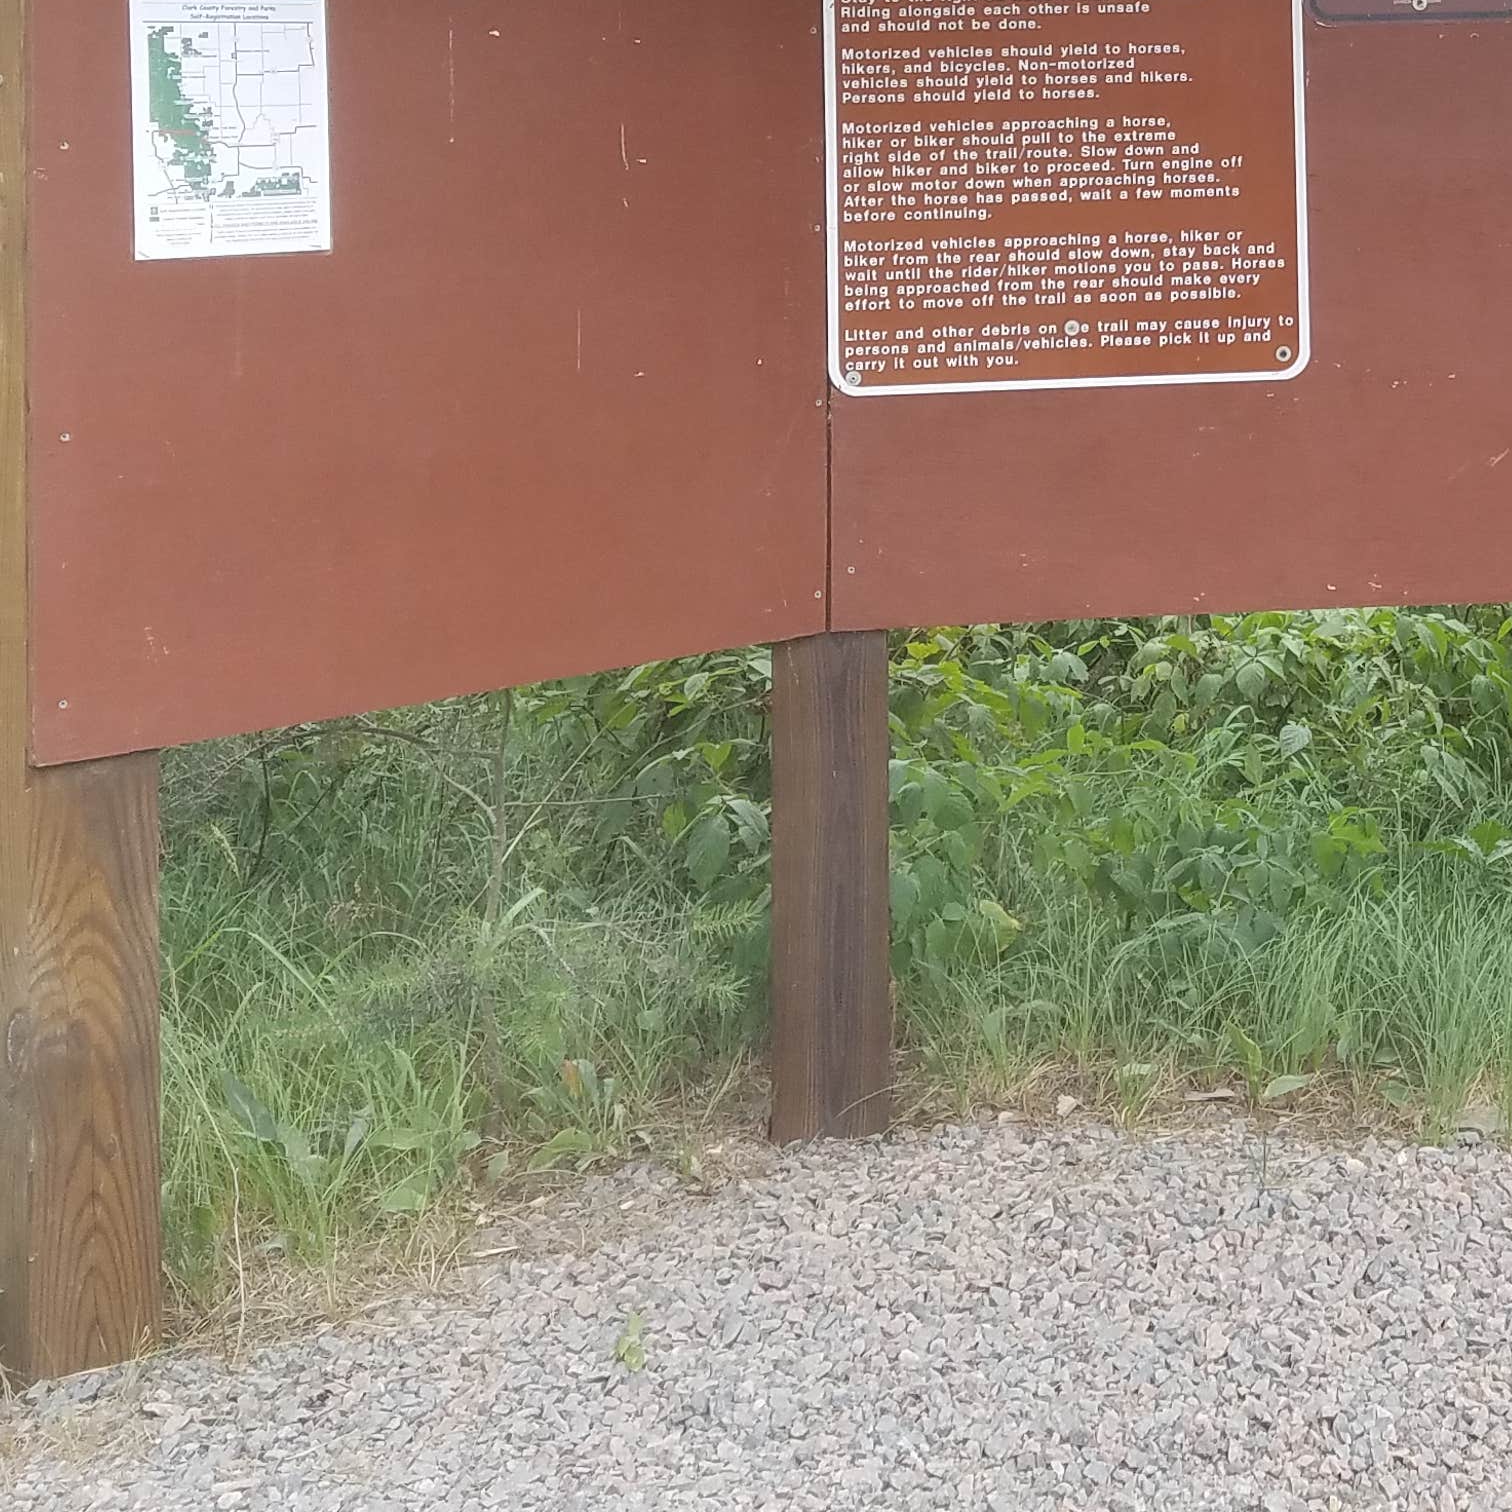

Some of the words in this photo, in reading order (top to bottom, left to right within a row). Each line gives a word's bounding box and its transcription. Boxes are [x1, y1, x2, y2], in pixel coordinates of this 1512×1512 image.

[840, 4, 890, 19] Riding
[898, 3, 975, 19] alongside
[983, 2, 1021, 15] each
[1027, 2, 1070, 17] other
[1076, 1, 1090, 14] is
[1097, 1, 1150, 13] unsafe
[840, 19, 870, 33] and
[877, 18, 930, 32] should
[937, 18, 964, 31] not
[970, 18, 990, 30] be
[997, 17, 1041, 30] done.
